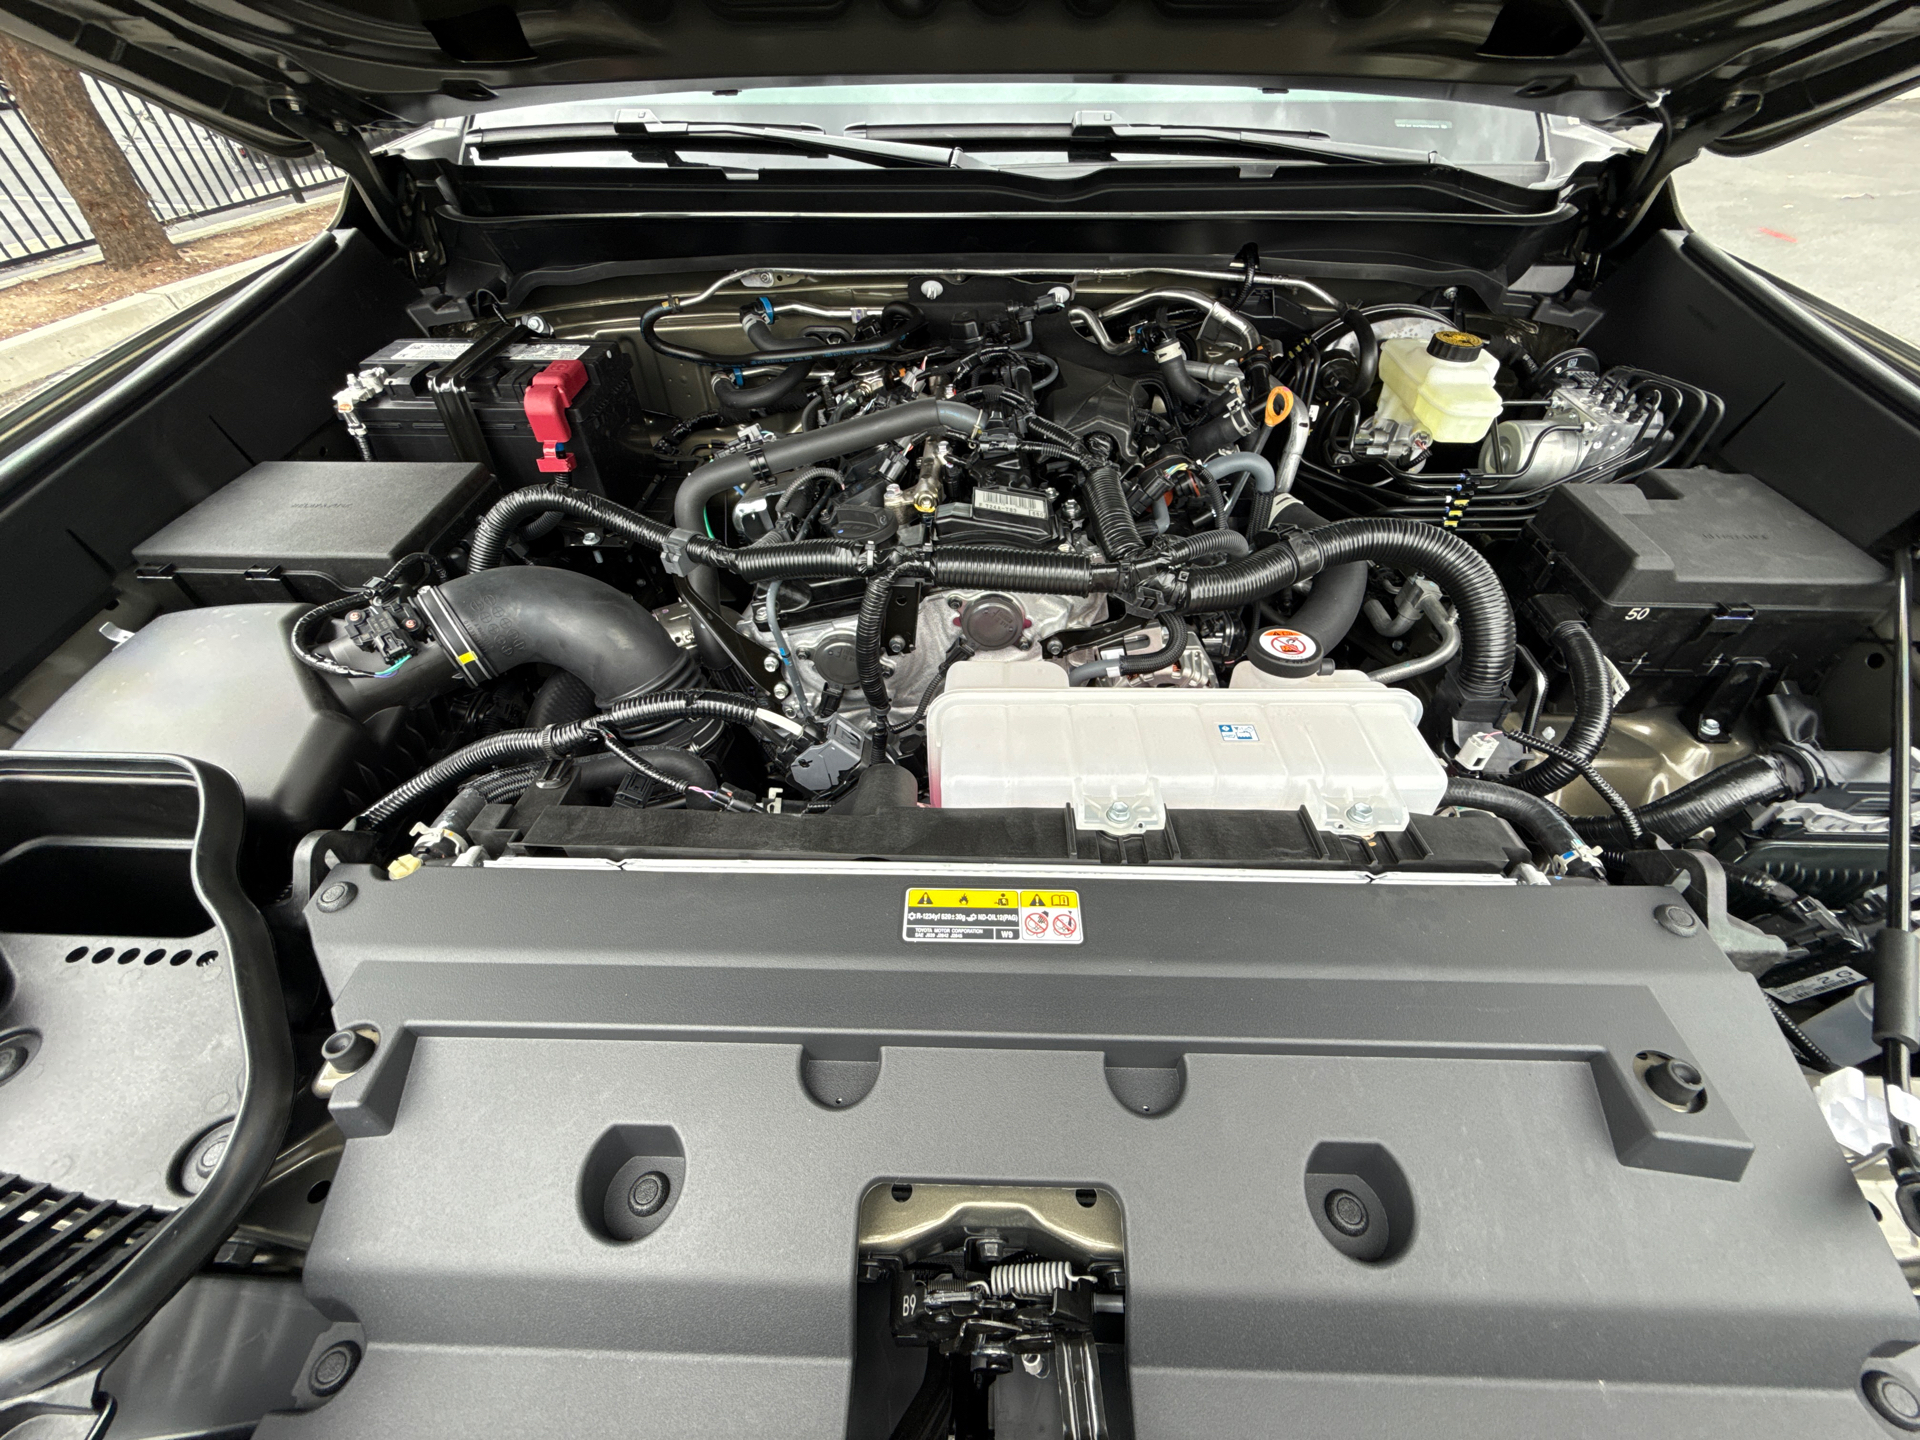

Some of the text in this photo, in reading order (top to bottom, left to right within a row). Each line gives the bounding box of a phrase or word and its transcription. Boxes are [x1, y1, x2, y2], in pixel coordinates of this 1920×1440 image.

[1624, 607, 1650, 620] 50
[1001, 930, 1014, 938] W9
[903, 1294, 917, 1317] B9
